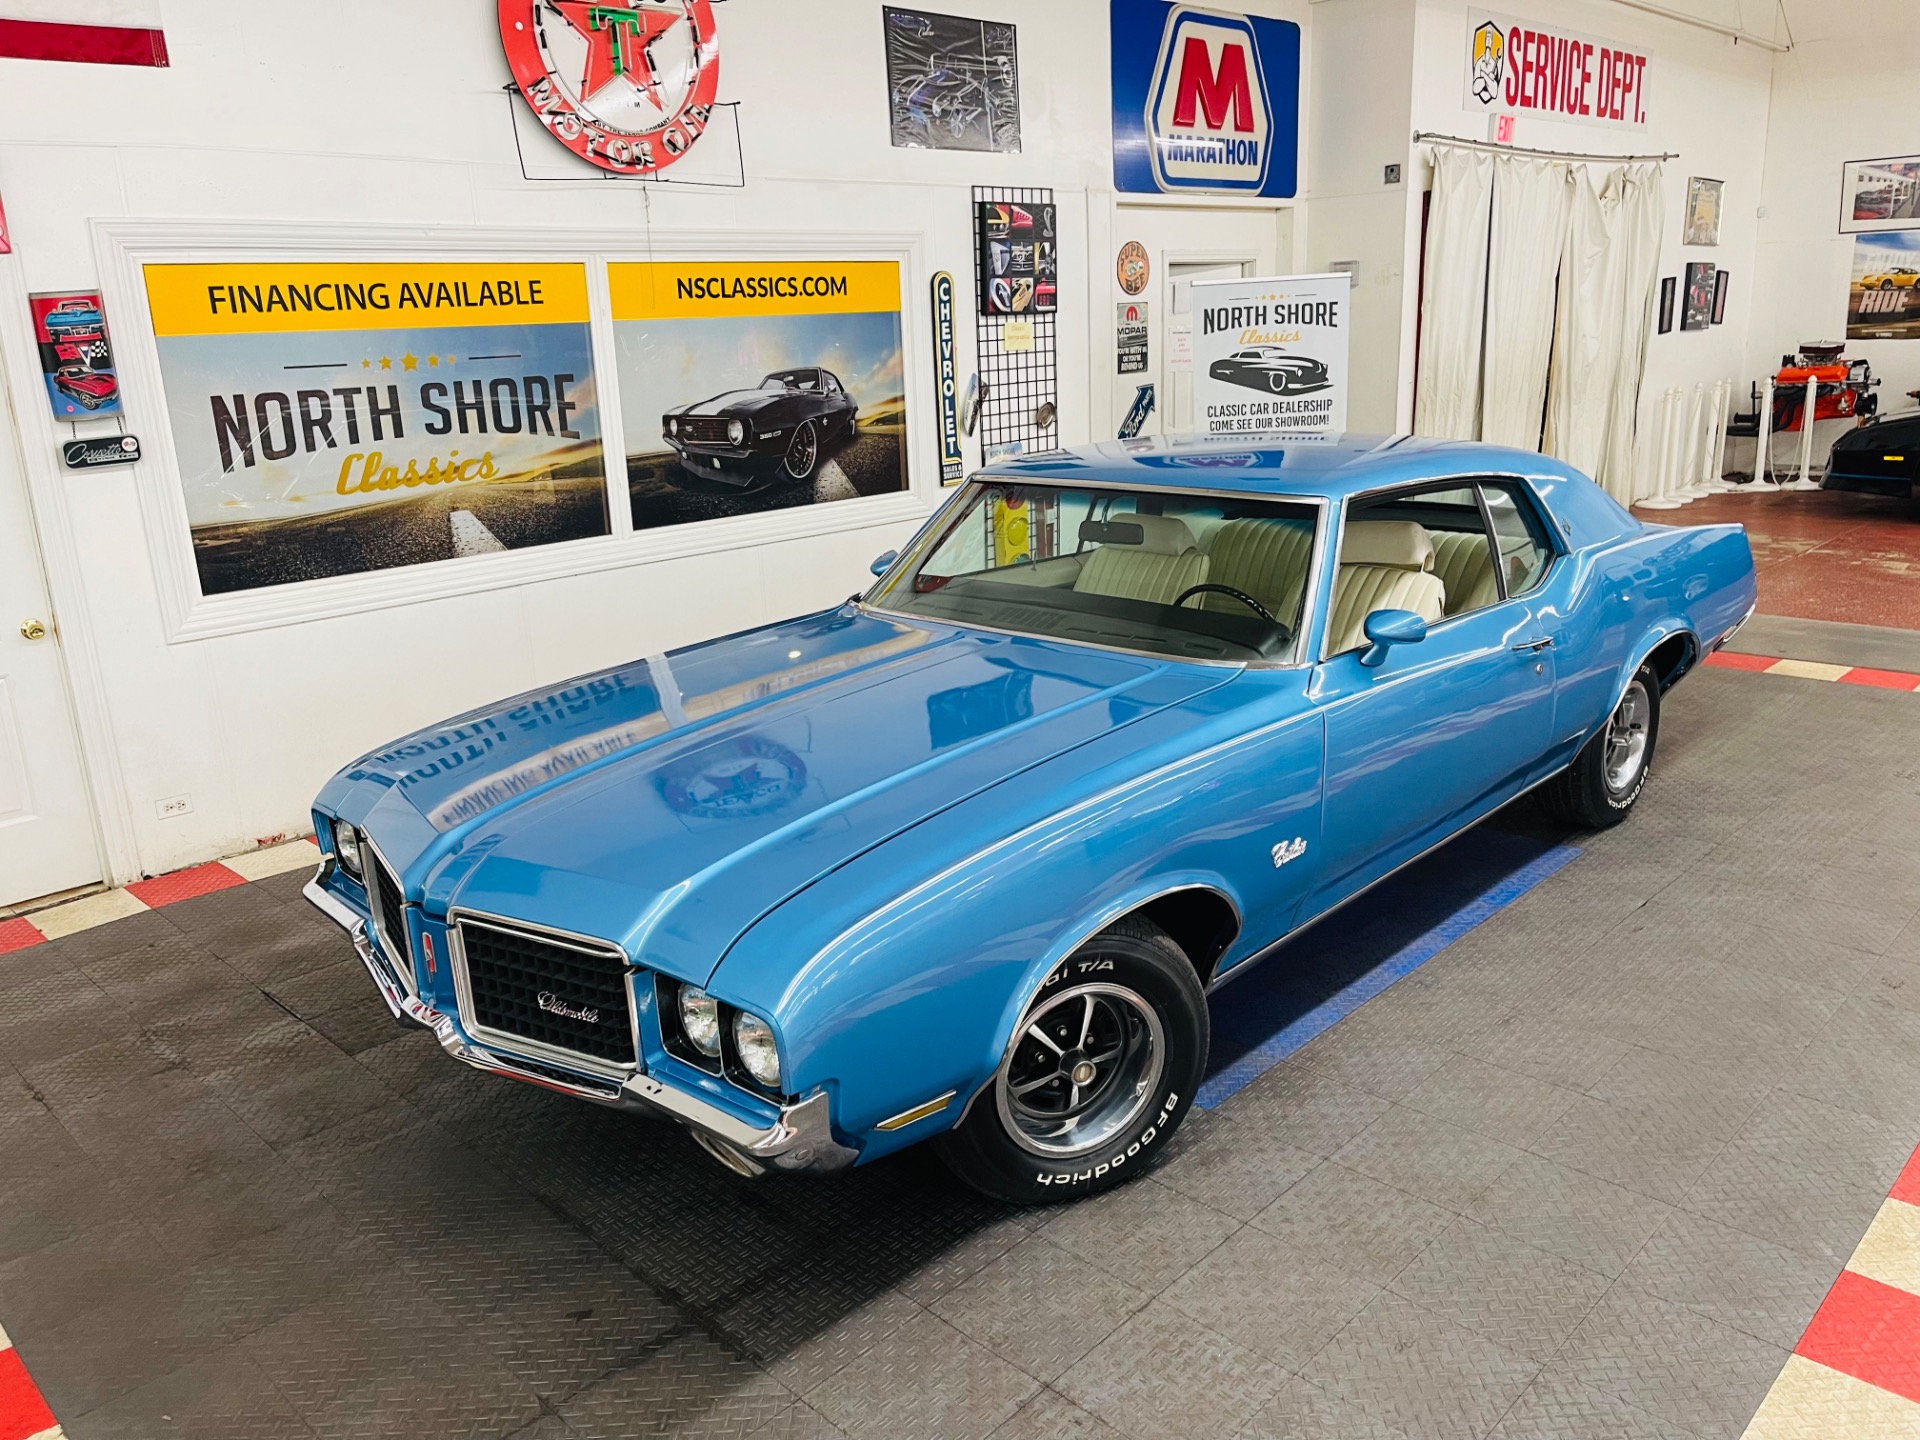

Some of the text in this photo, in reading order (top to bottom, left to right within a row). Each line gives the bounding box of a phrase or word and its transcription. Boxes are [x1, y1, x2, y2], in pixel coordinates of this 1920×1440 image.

[1172, 36, 1255, 133] M
[1505, 26, 1647, 123] SERVICE DEPT.
[527, 76, 712, 169] MOTOR OIL
[1497, 115, 1515, 142] EXIT
[1167, 133, 1258, 166] MARATHON
[207, 279, 545, 315] FINANCING AVAILABLE
[676, 276, 848, 300] NSCLASSICS.COM
[1858, 290, 1910, 314] RIDE
[1117, 326, 1147, 336] MOPAR
[1203, 301, 1339, 335] NORTH SHORE
[1239, 329, 1302, 345] Classics
[938, 281, 957, 455] CHEVROLET
[210, 372, 581, 473] NORTH SHORE
[1124, 404, 1145, 438] Ford
[1207, 399, 1333, 418] CLASSIC CAR DEALERSHIP
[1209, 414, 1329, 431] COME SEE OUR SHOWROOM!
[66, 442, 125, 465] Corvette
[943, 465, 957, 473] SALES
[336, 450, 500, 495] Classics
[943, 471, 963, 480] SERVICE
[1077, 959, 1115, 973] T/A
[537, 990, 599, 1024] Oldsmobile
[1036, 1091, 1180, 1186] BFGoodrich
